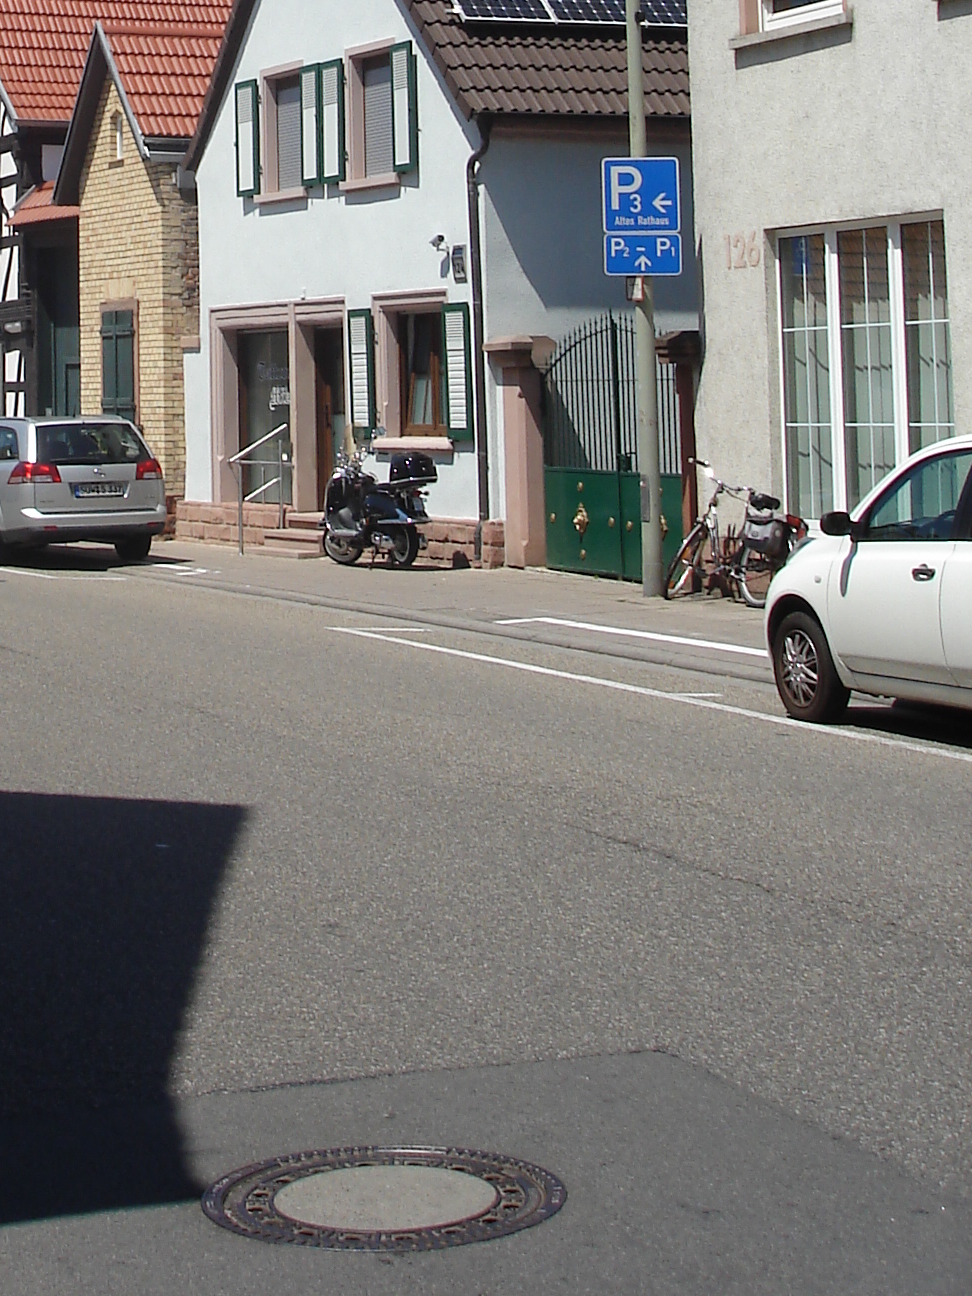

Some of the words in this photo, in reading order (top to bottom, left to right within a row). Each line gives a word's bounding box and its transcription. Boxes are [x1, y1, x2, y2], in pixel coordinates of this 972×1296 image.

[614, 216, 635, 226] Altes
[637, 215, 670, 226] Rathaus
[723, 231, 761, 271] 126
